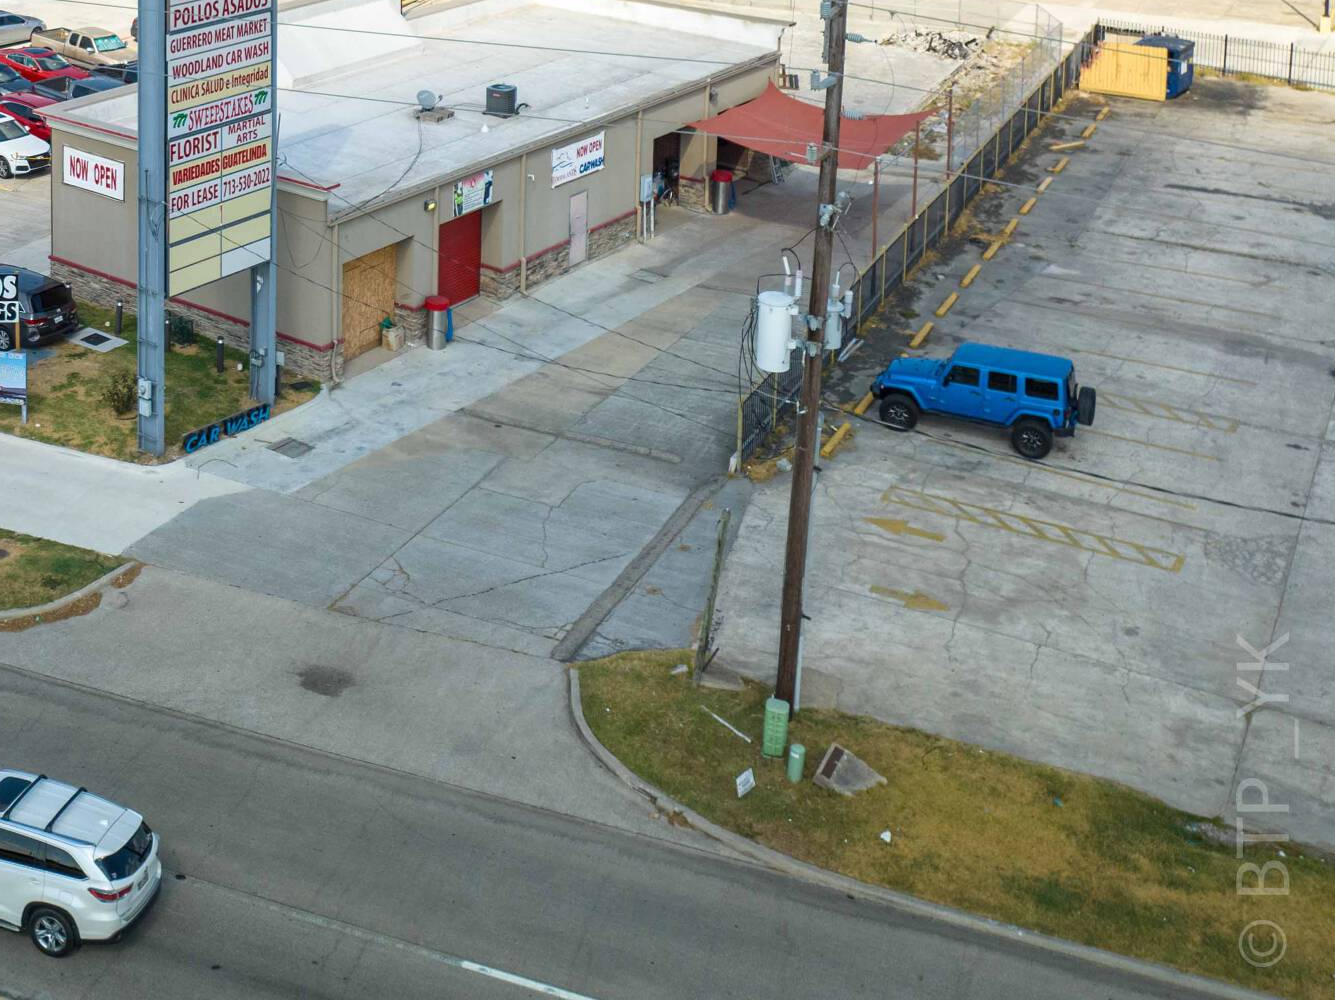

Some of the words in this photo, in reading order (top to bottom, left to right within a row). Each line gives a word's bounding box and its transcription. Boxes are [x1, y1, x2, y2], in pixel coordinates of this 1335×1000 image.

[173, 1, 219, 28] POLLOS
[170, 31, 213, 53] GUERRERO
[214, 25, 235, 43] MEAT
[236, 18, 267, 37] MARKET
[172, 54, 224, 80] WOODLAND
[225, 49, 242, 65] CAR
[244, 41, 269, 60] WASH
[171, 84, 200, 104] CLINICA
[201, 77, 224, 96] SALUD
[225, 79, 230, 89] e
[231, 65, 269, 88] Integridad
[188, 94, 254, 131] SWEEPSTAKES
[228, 116, 266, 135] MARTIAL
[170, 131, 219, 162] FLORIST
[236, 129, 258, 144] ARTS
[576, 144, 589, 158] NOW
[70, 155, 89, 181] NOW
[94, 163, 117, 191] OPEN
[172, 158, 220, 186] VARIEDADES
[222, 144, 267, 170] GUATELINDA
[171, 194, 189, 213] FOR
[192, 184, 219, 206] LEASE
[223, 167, 270, 197] 713-530-2022
[184, 425, 220, 453] CAR
[227, 406, 271, 436] WASH
